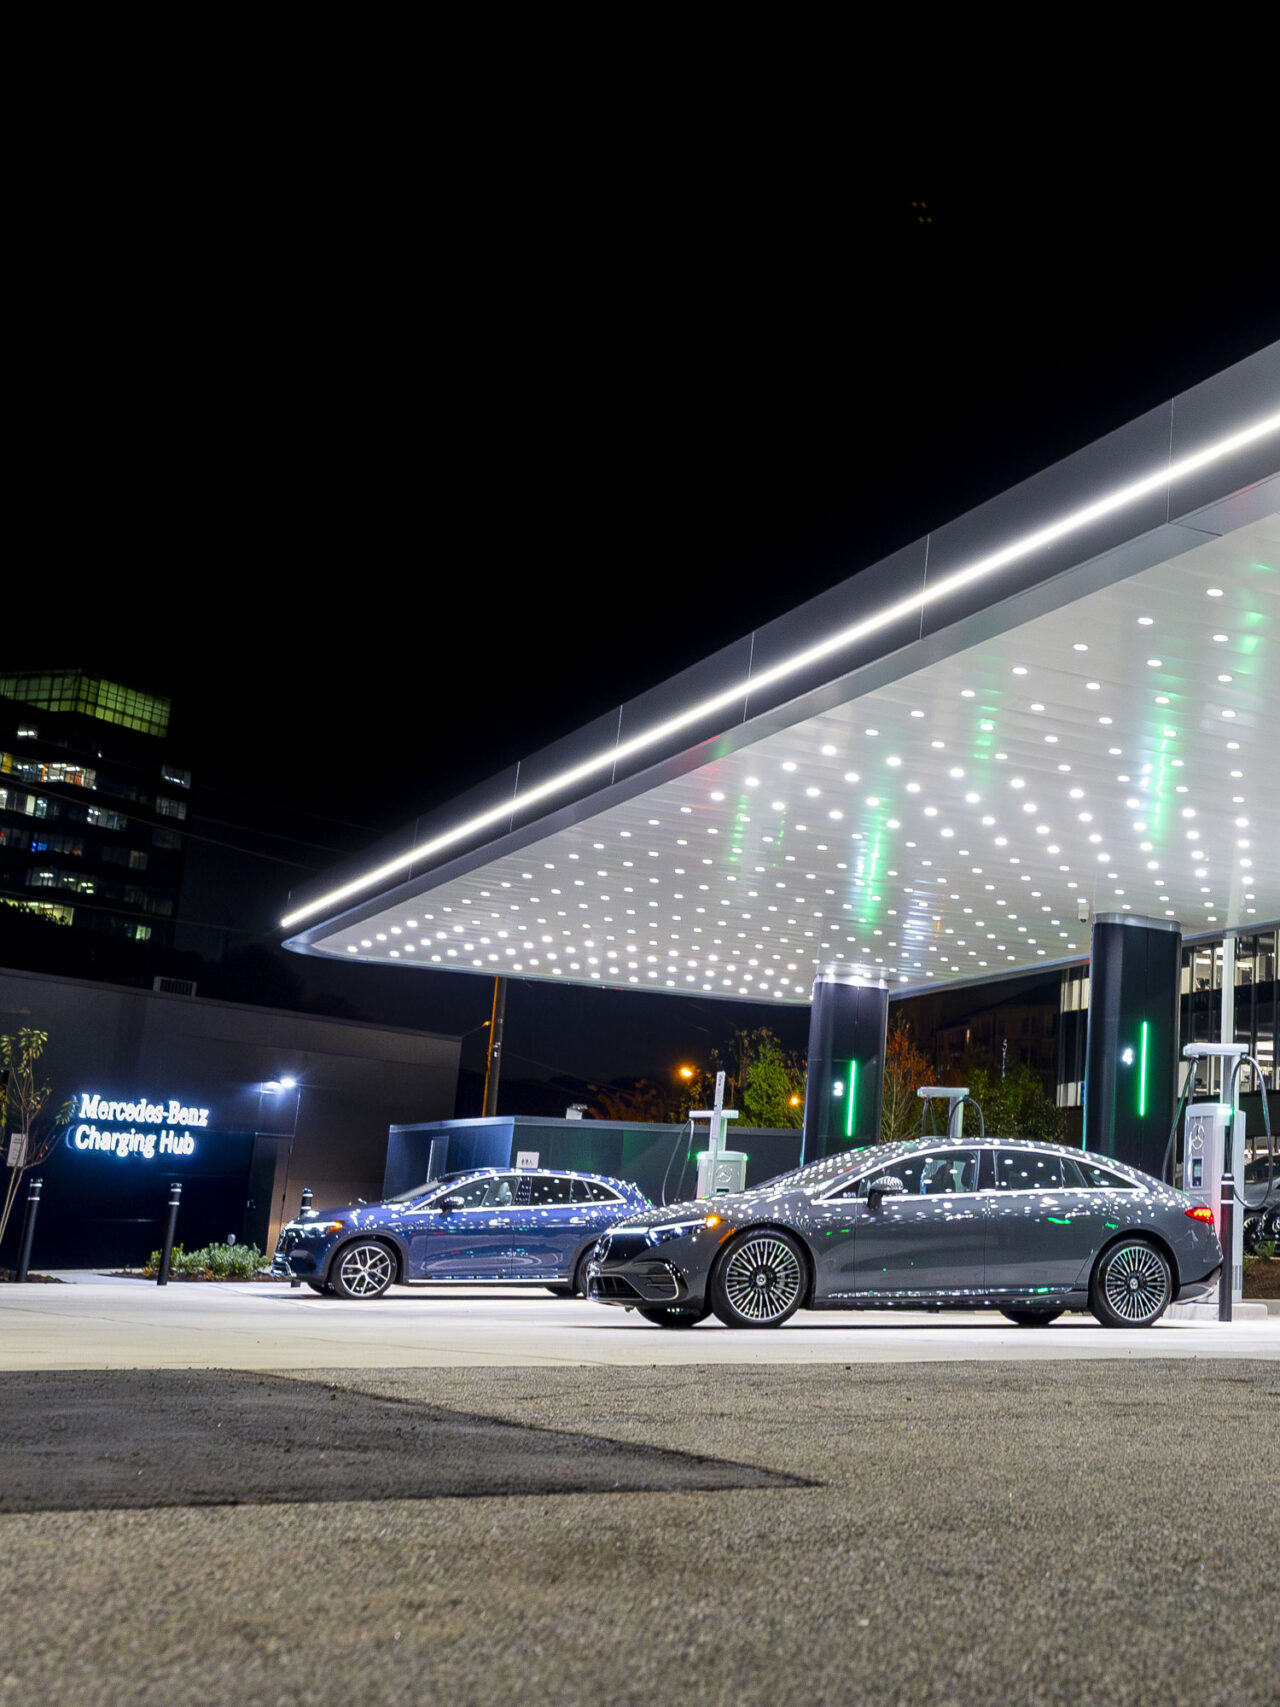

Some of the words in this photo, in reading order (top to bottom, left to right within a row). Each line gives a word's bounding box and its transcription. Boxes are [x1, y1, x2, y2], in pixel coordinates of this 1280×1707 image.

[1122, 1048, 1133, 1065] 4
[833, 1081, 844, 1097] 2
[78, 1093, 210, 1127] Mercedes-Benz
[75, 1124, 158, 1159] Charging
[159, 1129, 195, 1155] Hub
